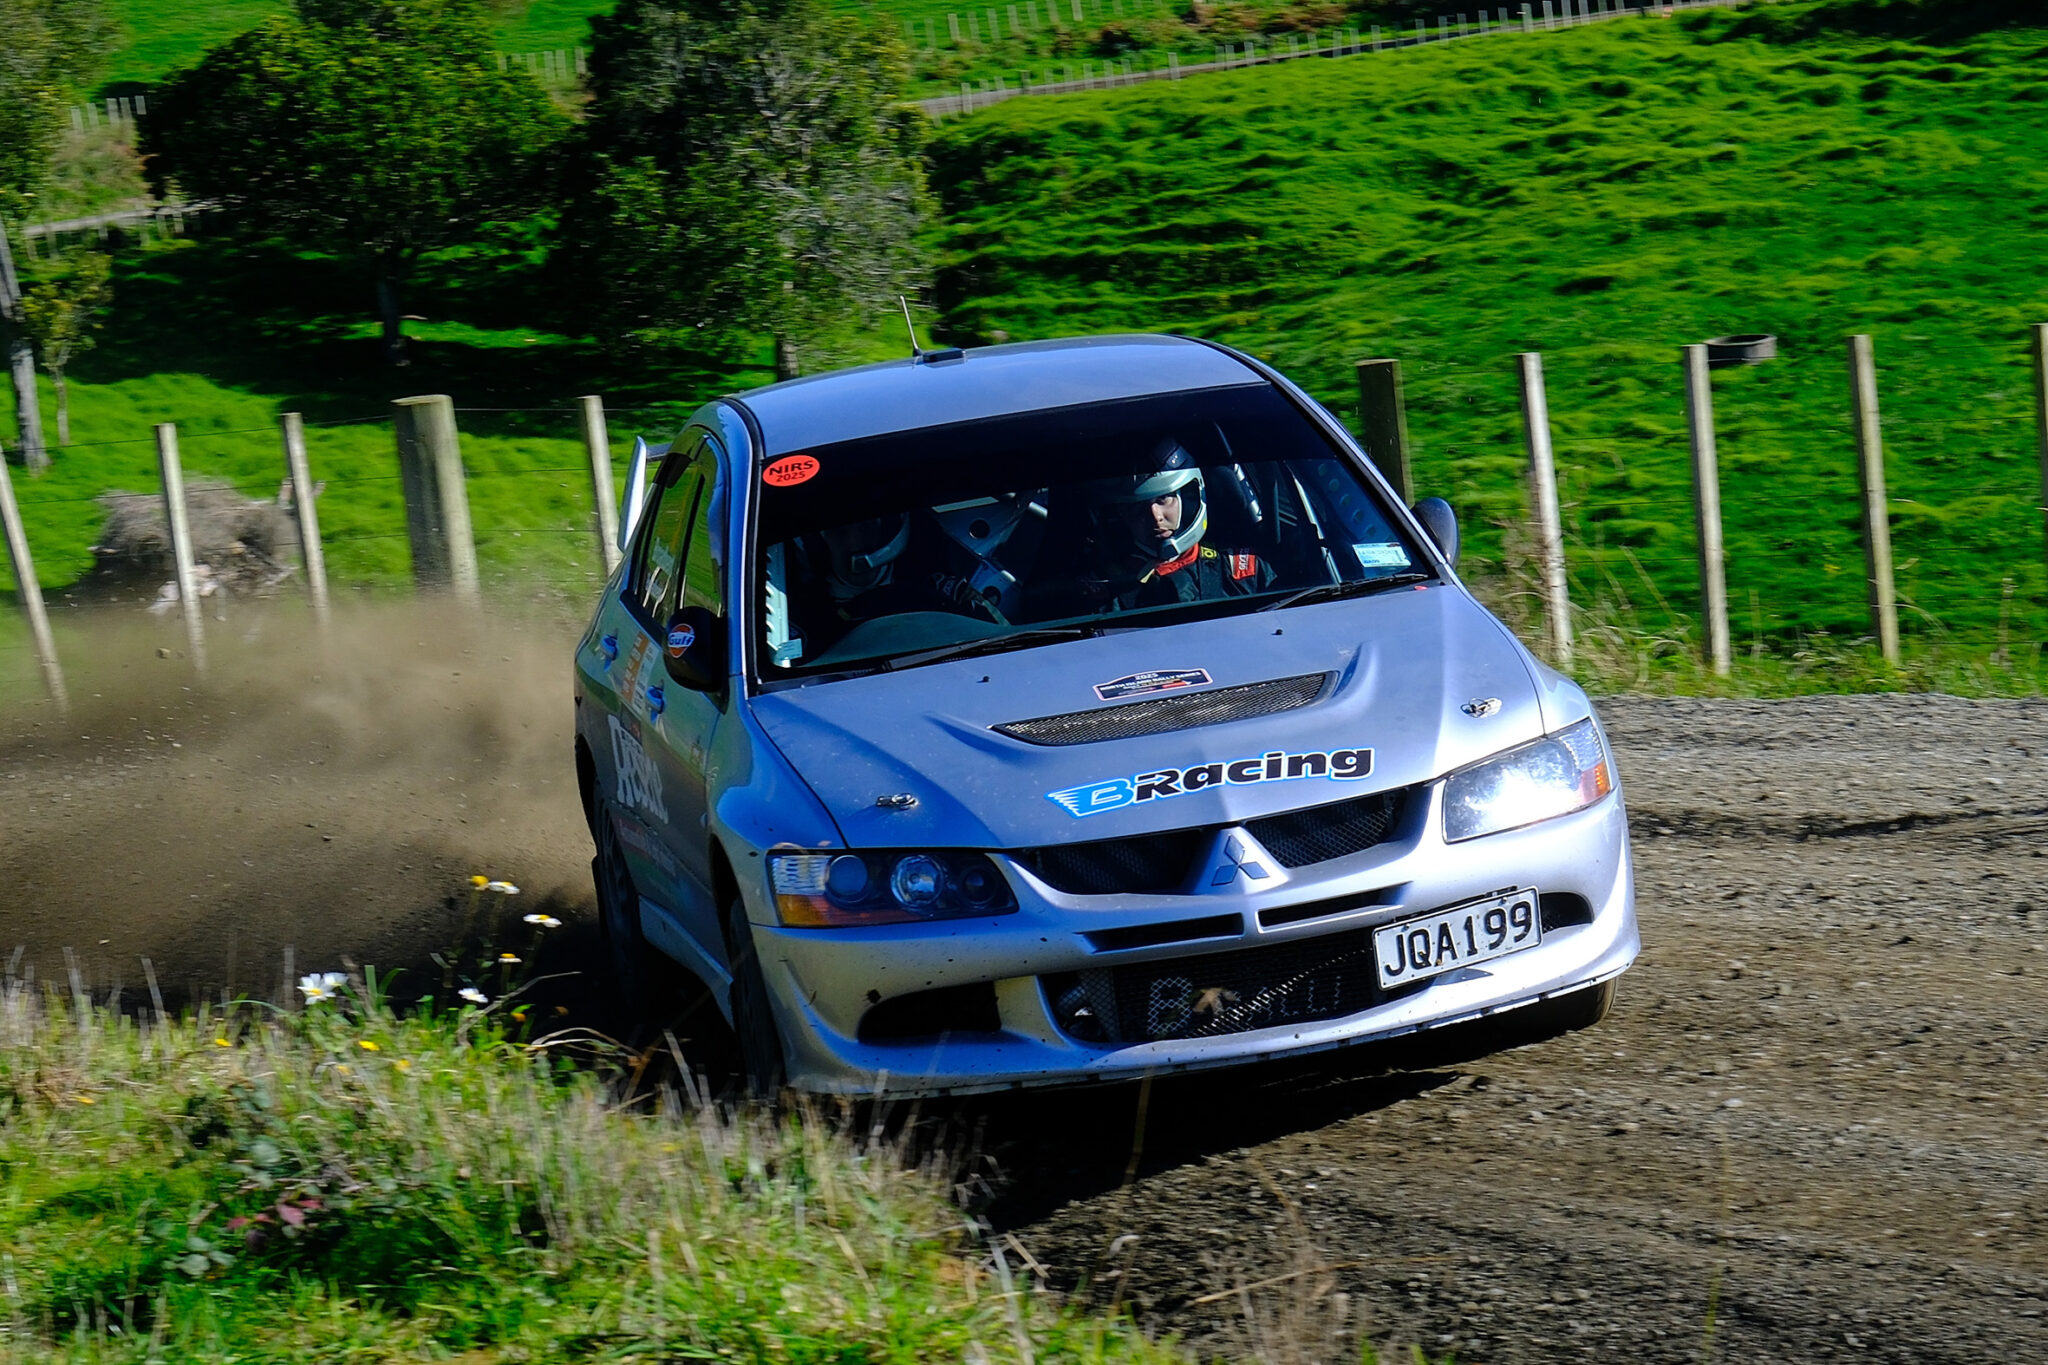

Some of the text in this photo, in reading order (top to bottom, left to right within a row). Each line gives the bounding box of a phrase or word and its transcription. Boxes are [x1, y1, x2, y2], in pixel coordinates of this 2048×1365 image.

[769, 460, 814, 476] NIRS
[776, 471, 806, 483] 2025
[669, 634, 694, 646] Gulf
[1384, 900, 1533, 977] JQA199
